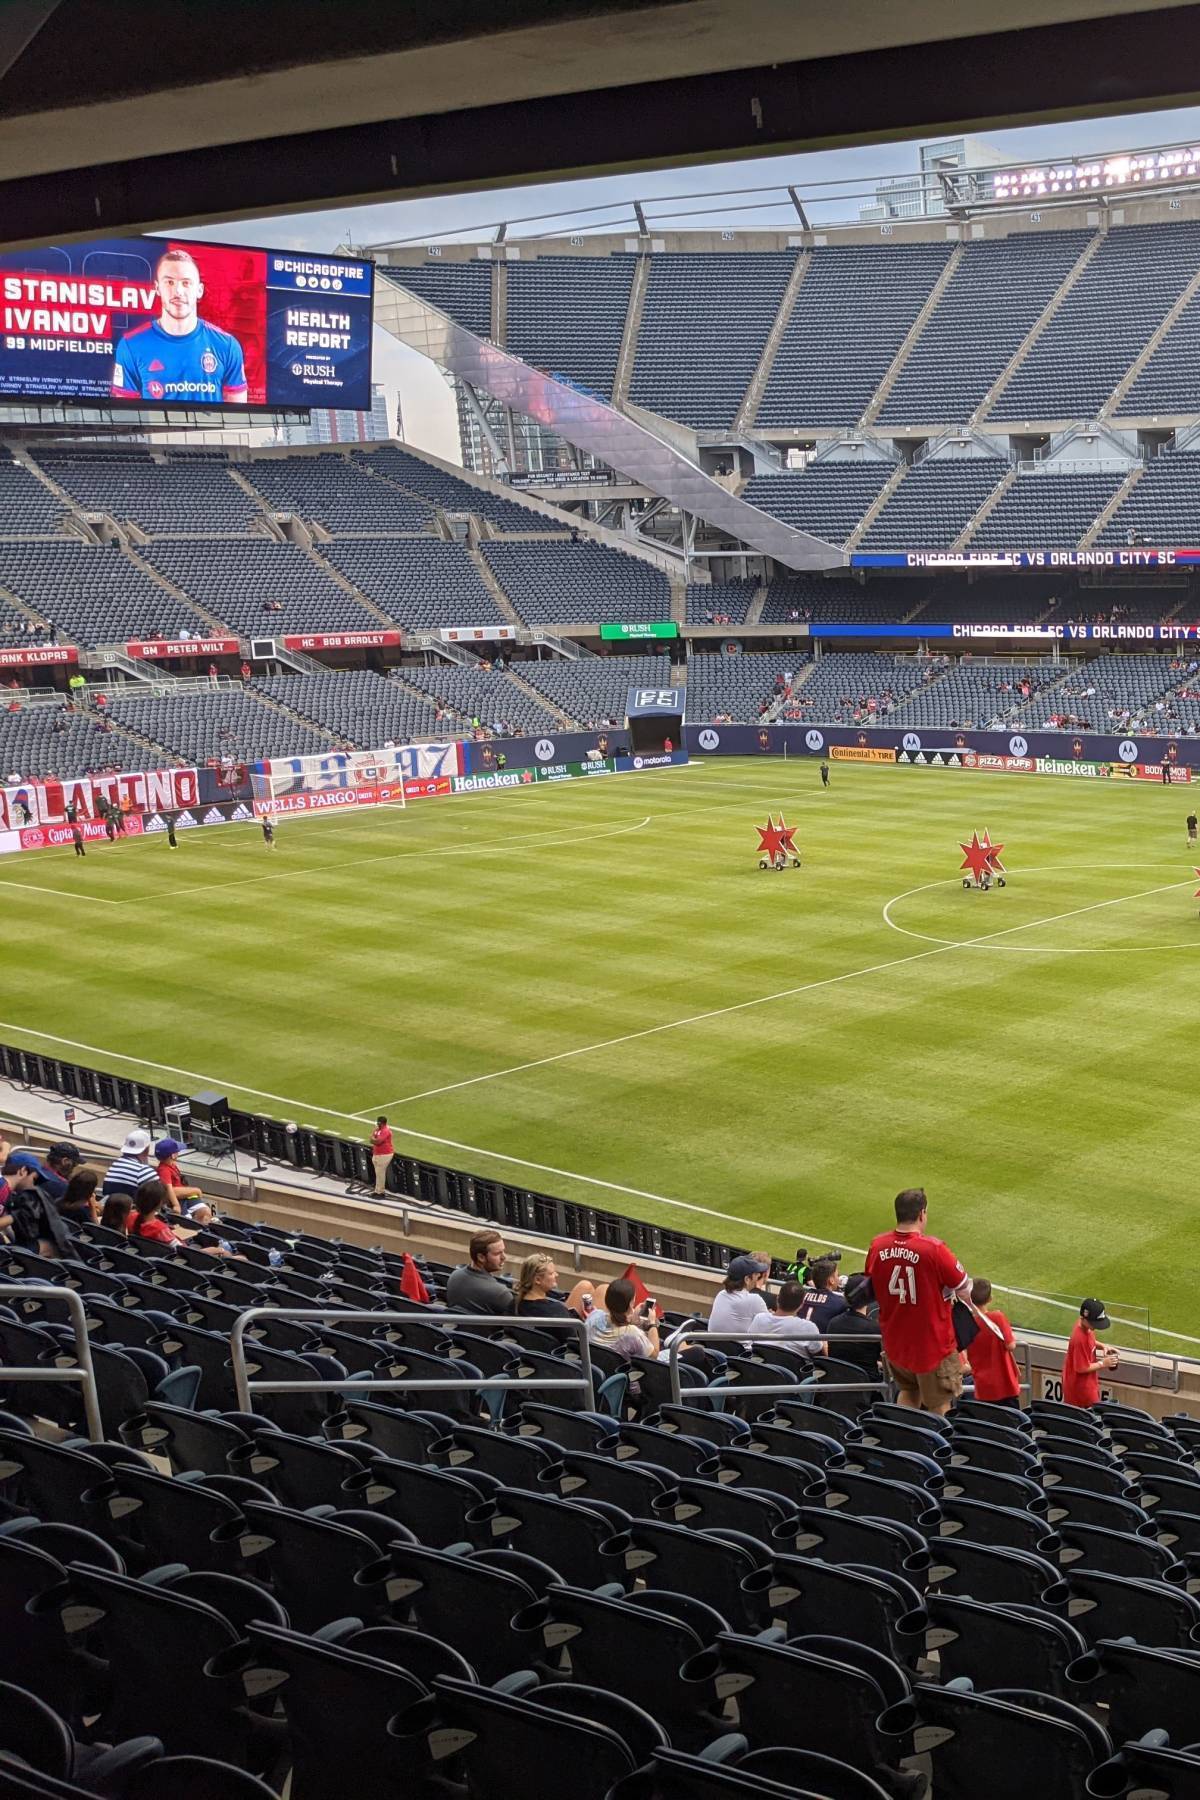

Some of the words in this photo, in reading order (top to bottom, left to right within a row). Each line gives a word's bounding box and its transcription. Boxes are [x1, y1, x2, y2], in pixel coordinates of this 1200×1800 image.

[428, 247, 441, 256] 427
[274, 259, 364, 279] @CHICAGOFIRE
[4, 278, 156, 310] STANISLAV
[5, 307, 107, 335] IVANOV
[286, 310, 351, 330] HEALTH
[6, 338, 26, 350] 99
[31, 339, 113, 354] MIDFIELDER
[286, 331, 351, 349] REPORT
[303, 365, 336, 377] RUSH
[165, 381, 216, 393] motorola
[1027, 552, 1045, 565] VS
[1050, 552, 1114, 565] ORLANDO
[1119, 551, 1150, 564] CITY
[1157, 551, 1176, 564] SC
[629, 624, 651, 632] RUSH
[1069, 625, 1087, 638] VS
[1092, 626, 1154, 639] ORLANDO
[1160, 627, 1191, 639] CITY
[302, 638, 315, 647] HC
[323, 636, 342, 646] BOB
[344, 635, 384, 645] BRADLEY
[143, 646, 158, 655] GM
[167, 643, 197, 654] PETER
[201, 642, 225, 653] WILT
[0, 653, 24, 663] ANK
[27, 651, 68, 661] KLOPAS
[640, 698, 672, 706] FC
[832, 748, 871, 759] Continental
[587, 760, 606, 768] RUSH
[643, 756, 672, 765] motorola
[979, 757, 1002, 767] PIZZA
[1007, 759, 1031, 770] PUFF
[1036, 758, 1096, 776] Heineken
[547, 765, 567, 774] RUSH
[1145, 766, 1187, 777] BODYMOR
[454, 774, 519, 792] Heineken
[37, 768, 200, 823] LATINO
[256, 798, 306, 815] WELLS
[309, 790, 356, 808] FARGO
[203, 815, 226, 824] adidas
[879, 1247, 920, 1264] BEAUFORD
[888, 1265, 917, 1305] 41
[804, 1293, 828, 1304] FIELDS
